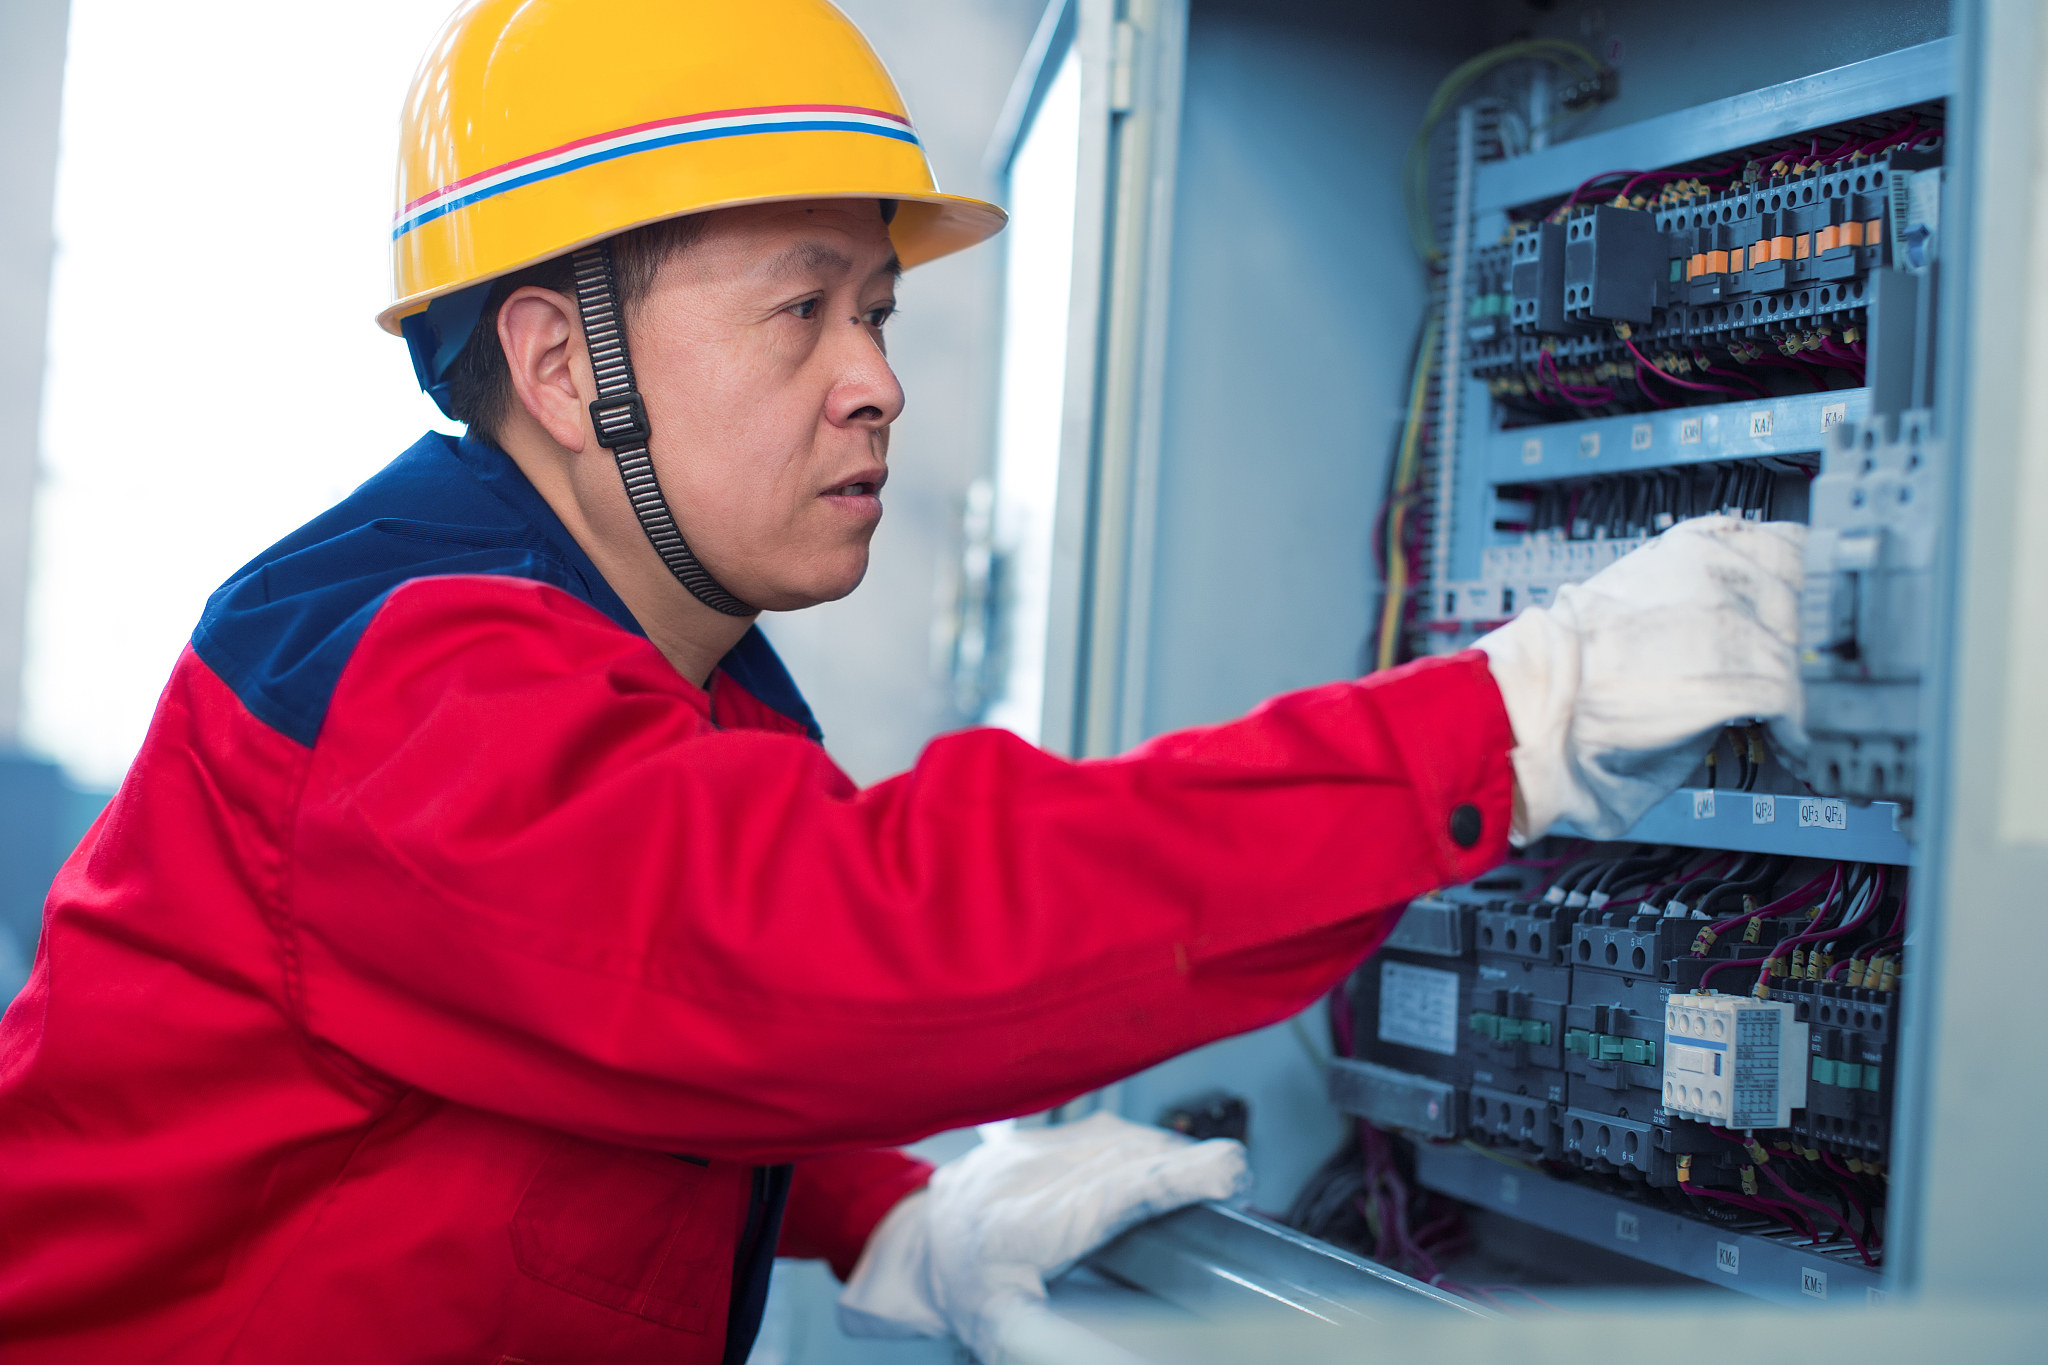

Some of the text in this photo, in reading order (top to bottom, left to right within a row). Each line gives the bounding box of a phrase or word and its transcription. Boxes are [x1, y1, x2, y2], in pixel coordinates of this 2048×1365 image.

[1753, 417, 1770, 434] KA1
[1824, 411, 1843, 428] KA2
[1755, 802, 1772, 819] QF2
[1801, 805, 1843, 825] QF3 QF4
[1604, 934, 1608, 943] 3
[1630, 938, 1635, 947] 5
[1569, 1138, 1574, 1148] 2
[1595, 1145, 1607, 1156] 4 T2
[1622, 1151, 1634, 1162] 6 T3
[1719, 1249, 1736, 1268] KM2
[1804, 1274, 1822, 1294] KM3
